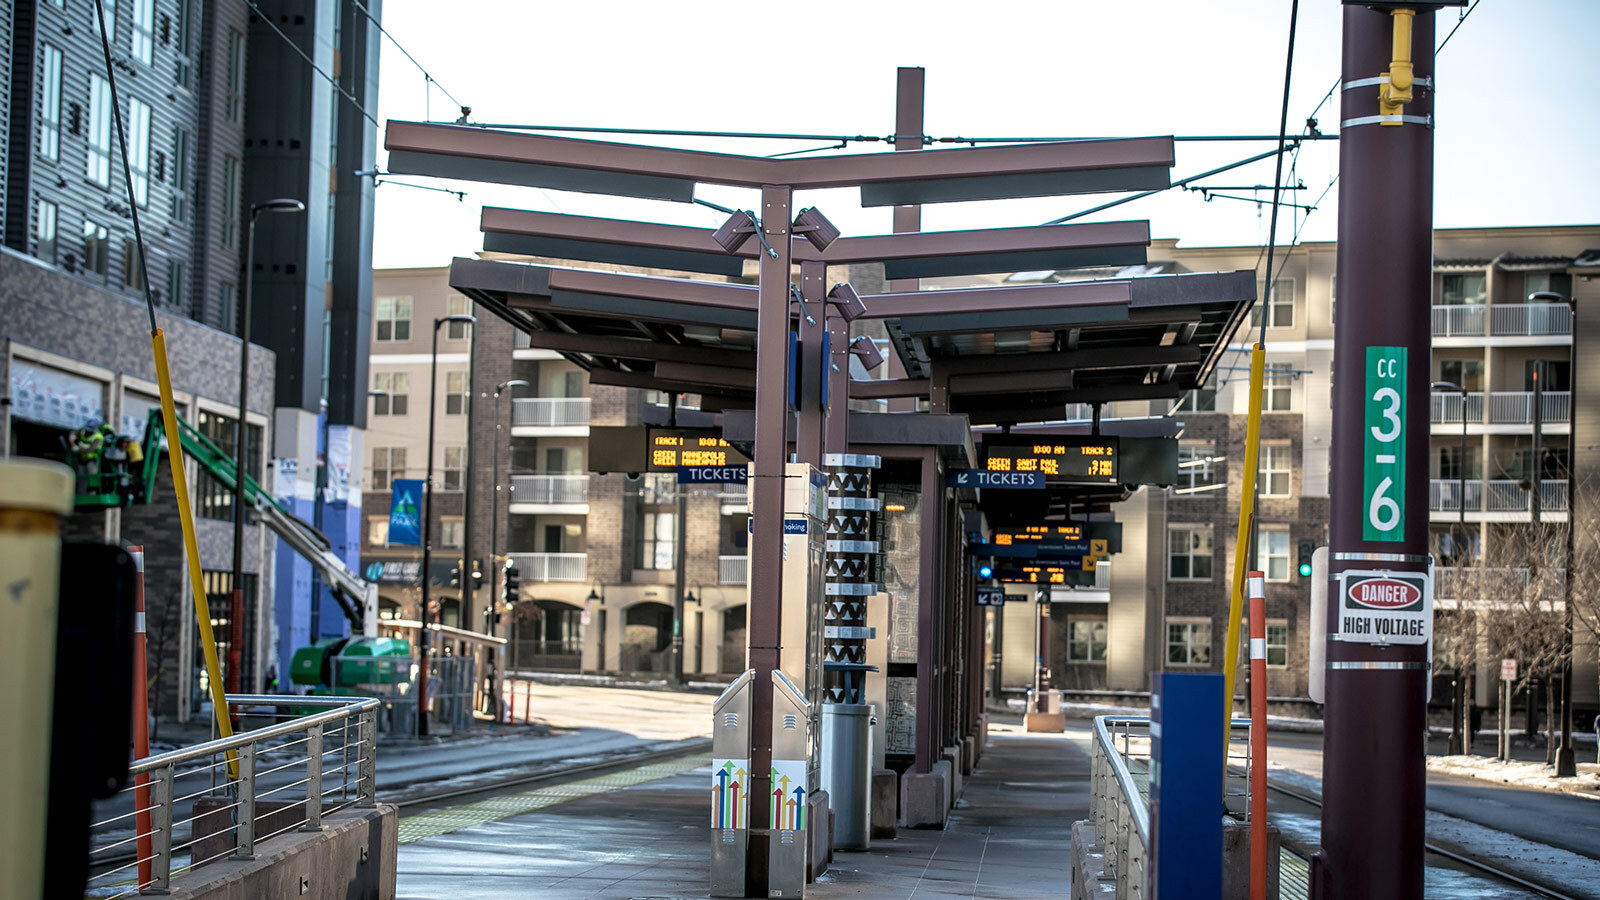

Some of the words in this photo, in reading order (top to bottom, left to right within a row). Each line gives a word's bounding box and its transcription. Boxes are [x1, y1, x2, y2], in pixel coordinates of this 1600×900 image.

[1377, 358, 1397, 378] CC
[655, 436, 677, 446] TRACK
[1033, 445, 1052, 455] 10:00
[1053, 446, 1065, 455] AM
[1080, 446, 1104, 456] TRACK
[1106, 447, 1113, 456] 2
[688, 468, 747, 481] TICKETS
[976, 472, 1035, 485] TICKETS
[1361, 583, 1408, 604] DANGER
[1343, 616, 1371, 635] HIGH
[1374, 617, 1425, 637] VOLTAGE
